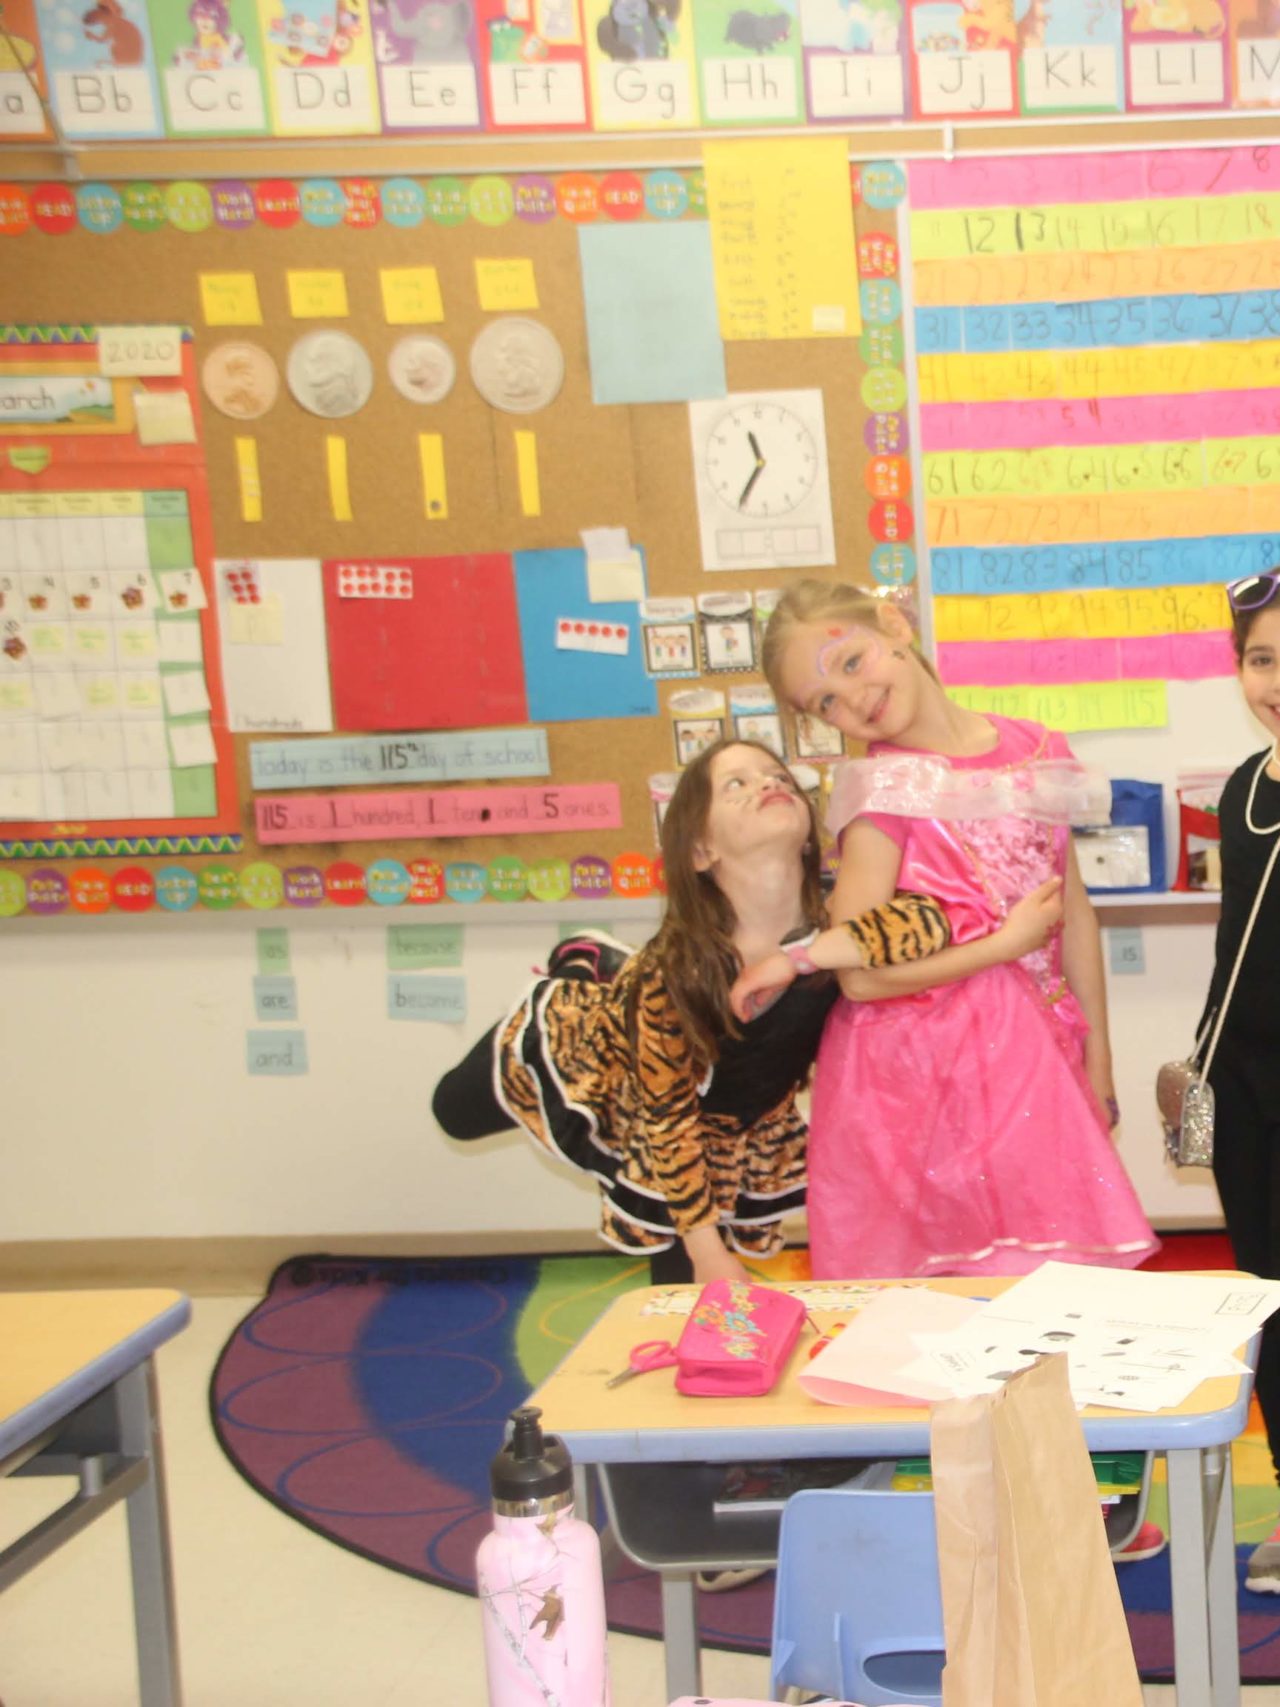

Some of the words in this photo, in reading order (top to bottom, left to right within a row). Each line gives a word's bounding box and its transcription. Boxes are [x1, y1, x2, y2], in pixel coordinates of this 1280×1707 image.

[71, 74, 133, 114] Bb
[184, 74, 244, 113] Cc
[292, 71, 352, 110] Dd
[408, 70, 457, 108] Ee
[511, 68, 558, 106] Ff
[613, 65, 676, 120] Gg
[721, 63, 778, 100] Hh
[839, 60, 872, 98] Ii
[937, 55, 986, 112] Jj
[1043, 49, 1097, 88] Kk
[1155, 48, 1197, 86] Ll
[1252, 145, 1273, 174] 8
[964, 214, 997, 255] 12
[1013, 208, 1048, 253] 13
[1012, 309, 1053, 343] 33
[1105, 299, 1147, 337] 35
[107, 340, 175, 363] 2020
[927, 457, 960, 495] 61
[1117, 547, 1154, 583] 85
[253, 747, 308, 784] Today
[340, 744, 374, 773] the
[417, 741, 448, 778] day
[483, 736, 546, 767] school
[262, 803, 289, 830] 115
[327, 799, 339, 829] 1
[427, 796, 436, 825] 1
[497, 794, 529, 820] and
[541, 791, 560, 820] 5
[573, 876, 611, 888] Polite!
[1122, 947, 1138, 963] is
[259, 993, 291, 1011] are
[255, 1040, 293, 1068] and
